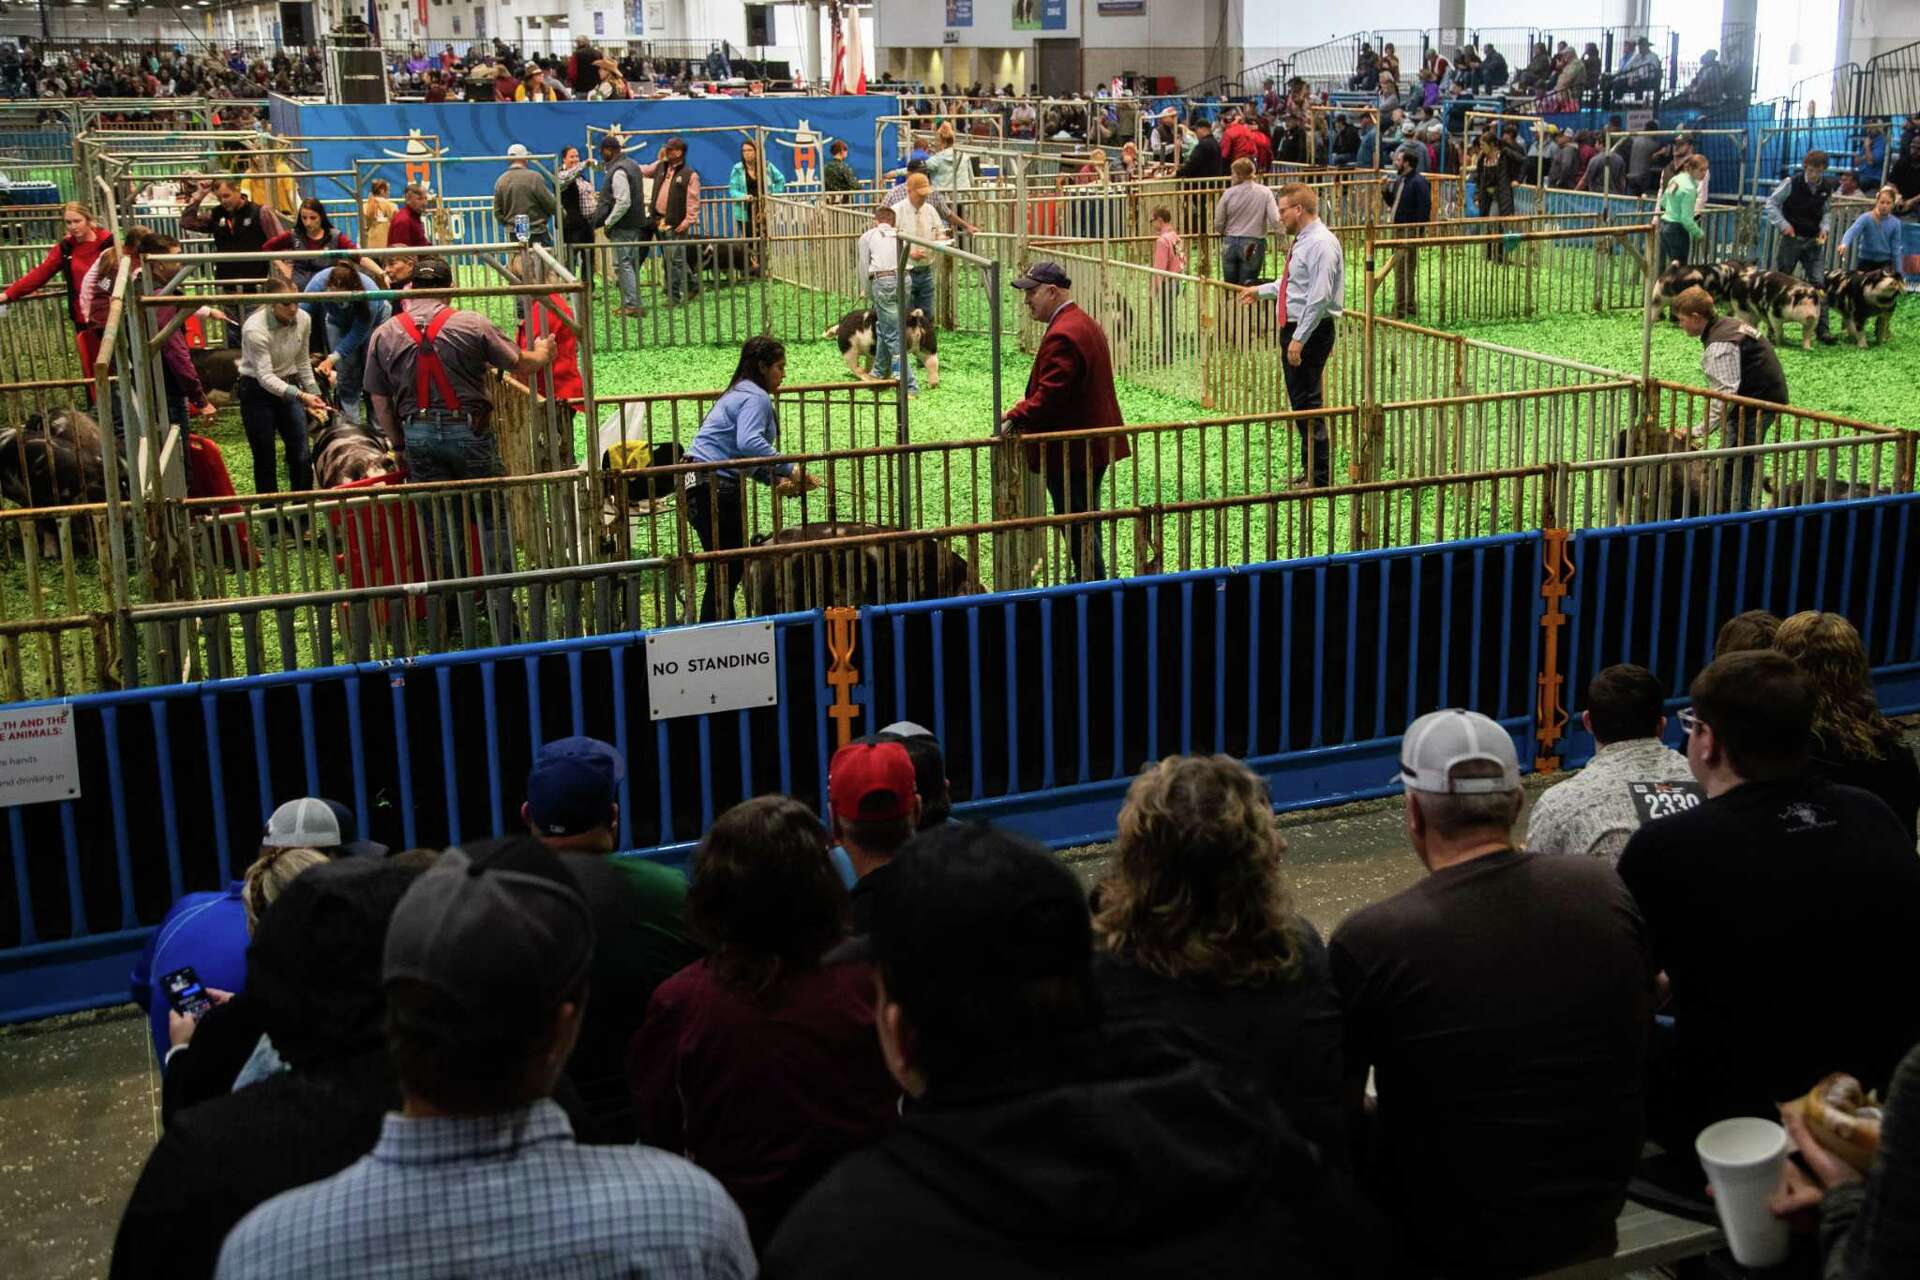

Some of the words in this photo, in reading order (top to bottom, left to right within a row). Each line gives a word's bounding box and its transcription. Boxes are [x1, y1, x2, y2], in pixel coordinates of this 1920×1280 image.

[653, 661, 679, 676] NO
[688, 651, 770, 673] STANDING
[20, 718, 44, 729] AND
[47, 716, 67, 726] THE
[8, 727, 63, 740] ANIMALS:
[9, 755, 37, 766] hands
[16, 774, 54, 785] drinking
[55, 772, 65, 781] in
